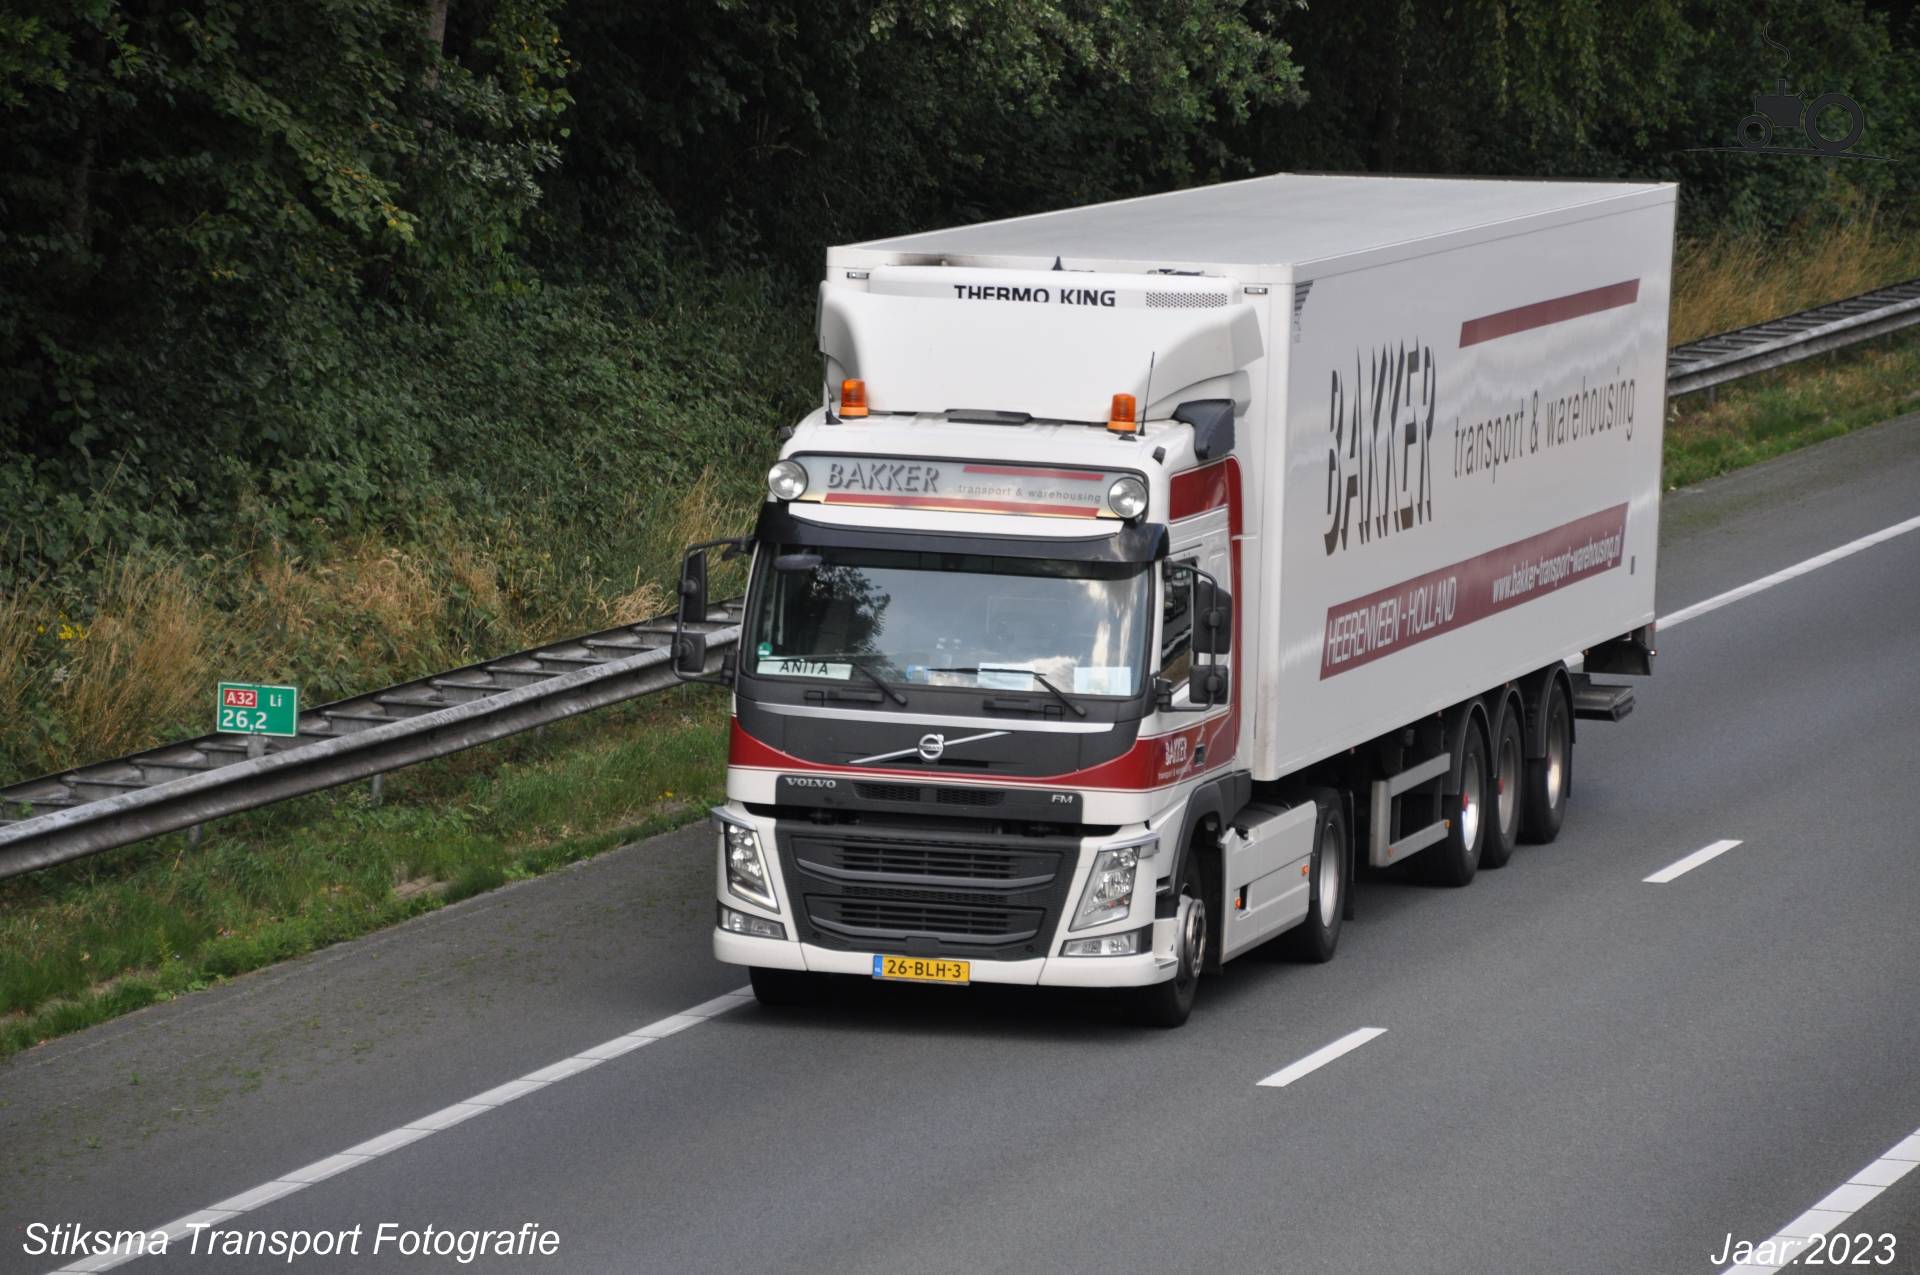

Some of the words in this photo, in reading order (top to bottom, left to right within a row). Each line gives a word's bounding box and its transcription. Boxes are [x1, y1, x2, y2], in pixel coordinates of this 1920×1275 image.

[954, 284, 1050, 303] THERMO
[1060, 288, 1116, 307] KING
[1453, 398, 1525, 484] transport
[1529, 389, 1540, 455] &
[1546, 365, 1636, 444] warehousing
[1324, 335, 1437, 556] BAKKER
[827, 461, 940, 493] BAKKER
[958, 484, 1011, 497] transport
[1015, 487, 1023, 497] &
[1027, 490, 1101, 505] warehousing
[779, 660, 829, 675] ANITA
[226, 691, 254, 706] A32
[269, 694, 282, 707] Li
[222, 709, 268, 731] 26,2
[785, 777, 837, 789] VOLVO
[1051, 794, 1073, 804] FM
[887, 959, 963, 979] 26-BLH-3
